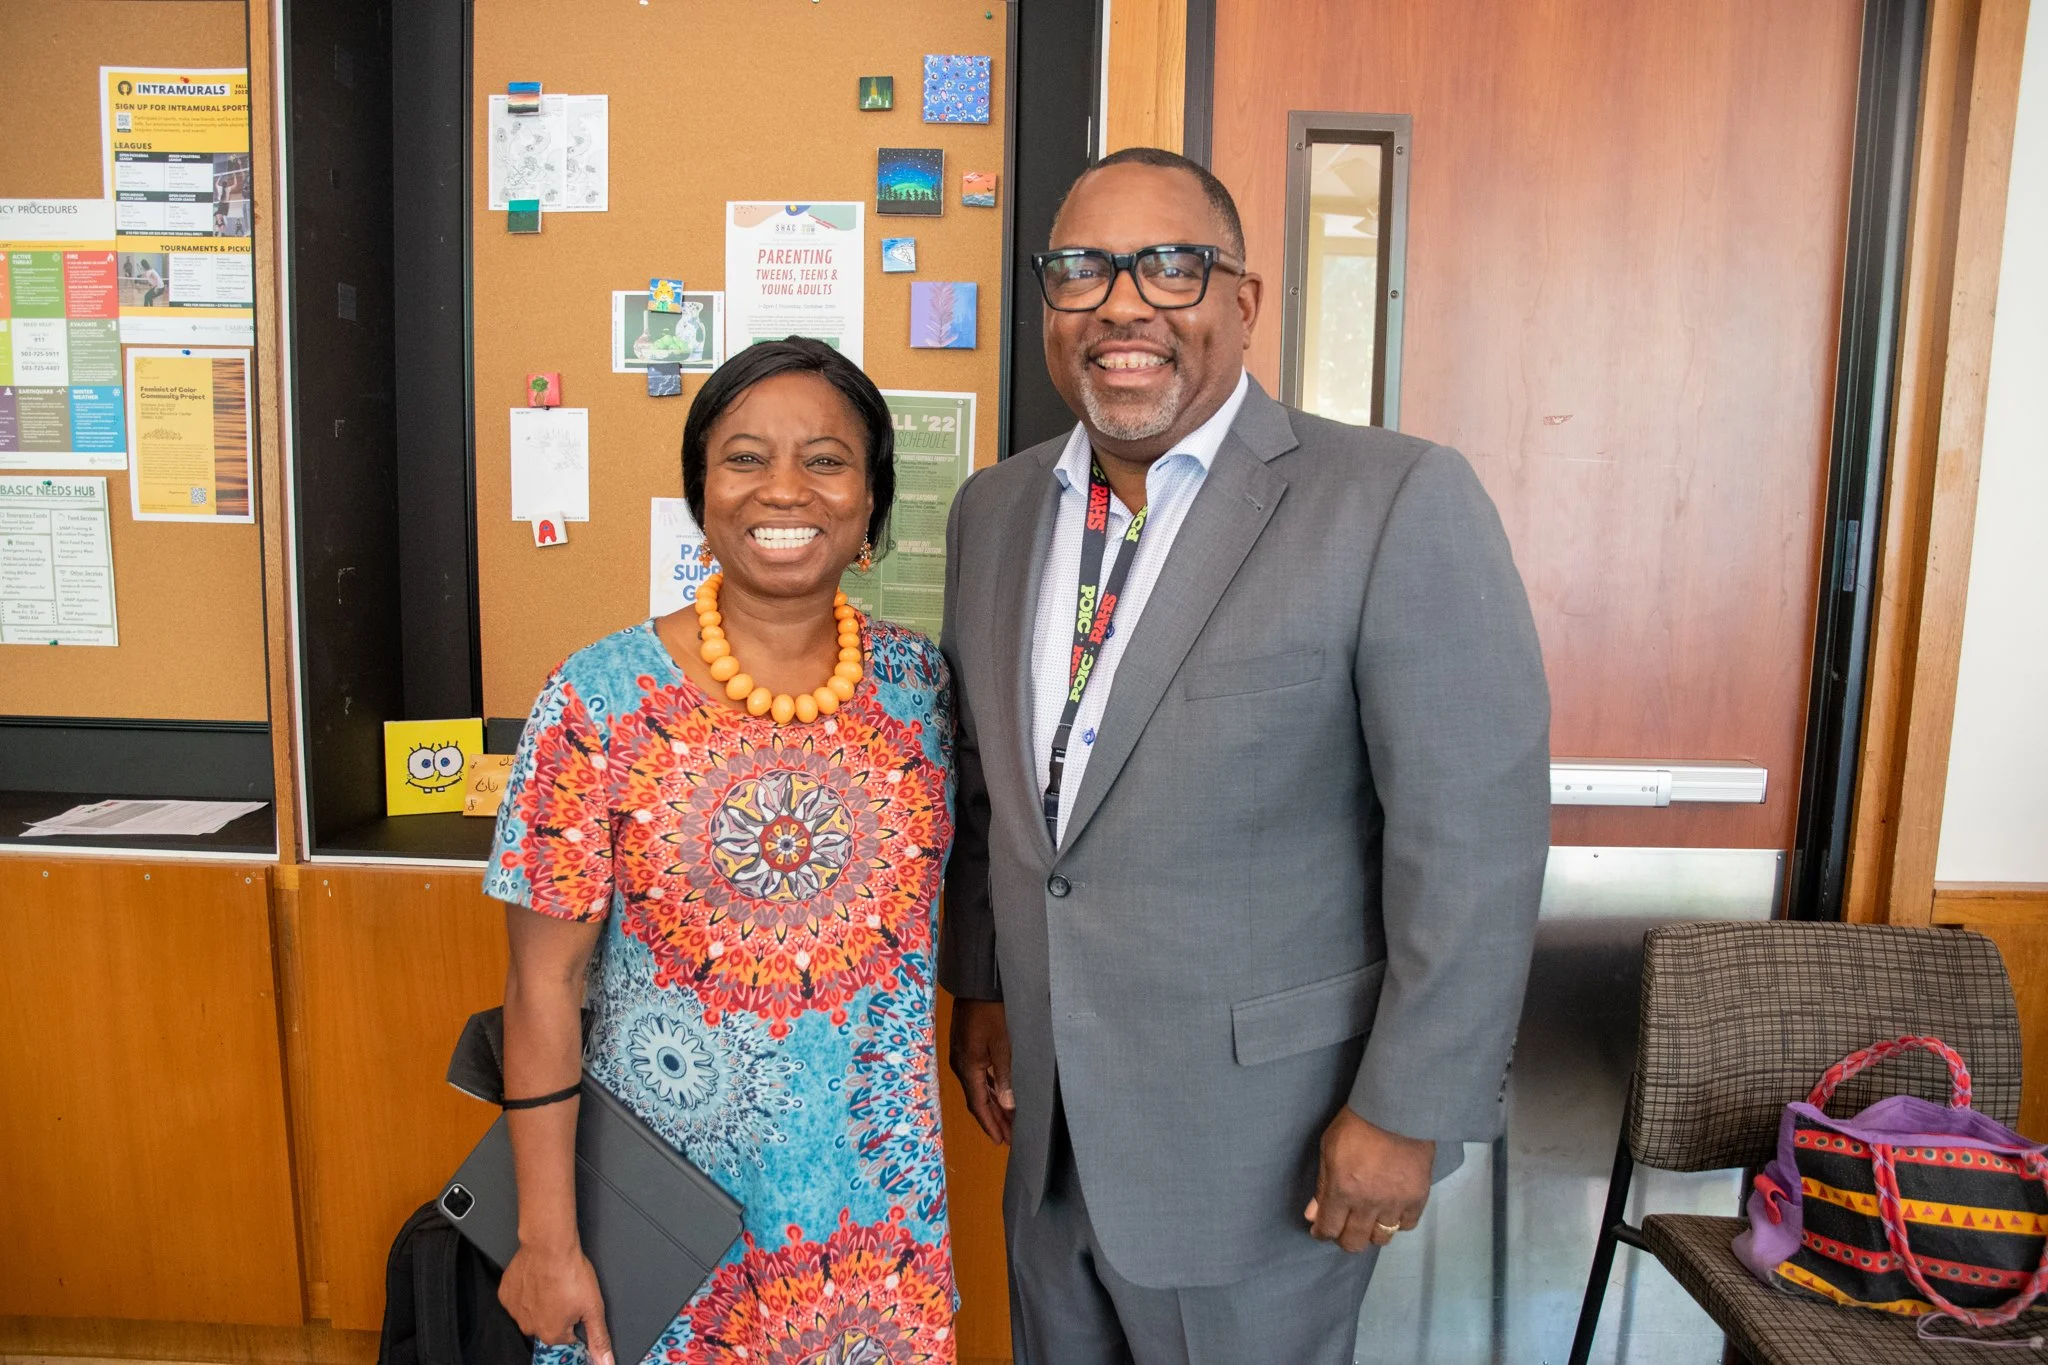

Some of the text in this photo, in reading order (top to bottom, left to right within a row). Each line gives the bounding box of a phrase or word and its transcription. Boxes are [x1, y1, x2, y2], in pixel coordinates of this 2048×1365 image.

[138, 84, 225, 95] INTRAMURALS
[115, 103, 134, 111] SIGN
[168, 104, 220, 112] INTRAMURAL
[18, 205, 78, 214] PROCEDURES
[776, 224, 796, 232] SHAC
[758, 249, 832, 264] PARENTING
[756, 269, 838, 282] TWEENS, TEENS &
[762, 284, 832, 295] YOUNG ADULTS
[896, 432, 950, 449] SCHEDULE
[0, 485, 96, 496] BASIC NEEDS HUB
[1087, 483, 1108, 531] RAHS
[1077, 585, 1096, 634] POIC
[1069, 653, 1094, 702] POIC
[1088, 592, 1117, 644] RAHS
